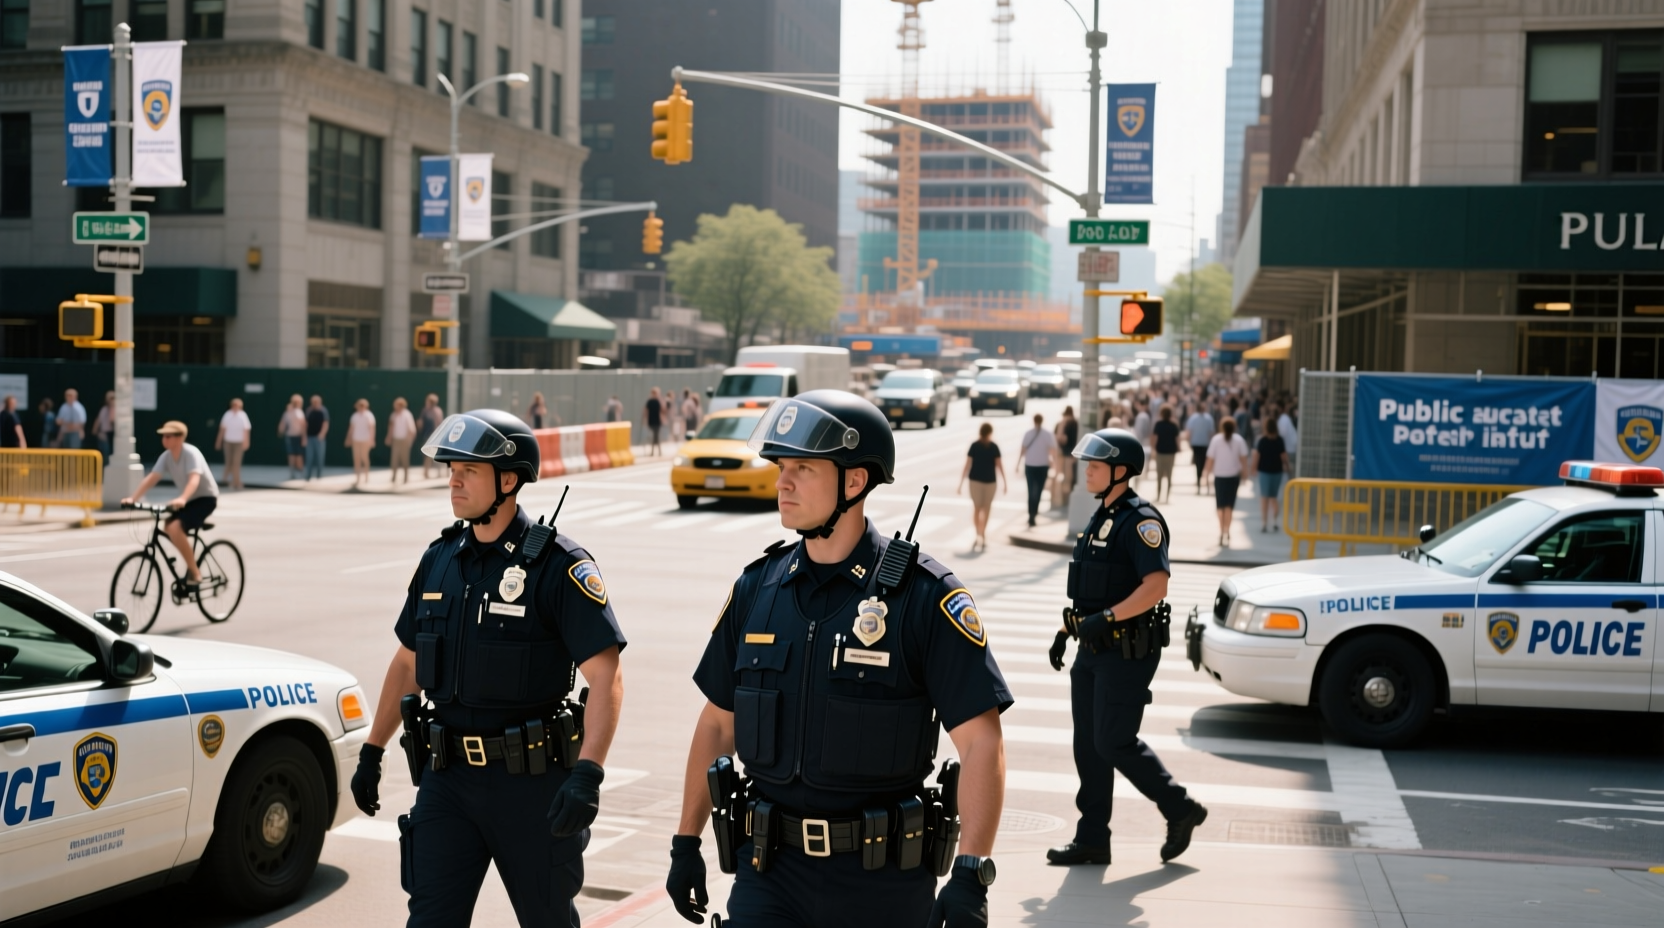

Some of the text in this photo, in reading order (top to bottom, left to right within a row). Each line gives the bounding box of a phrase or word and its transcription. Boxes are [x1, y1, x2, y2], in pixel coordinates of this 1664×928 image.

[1379, 398, 1464, 424] Public
[1527, 620, 1645, 656] POLICE
[247, 682, 317, 709] POLICE
